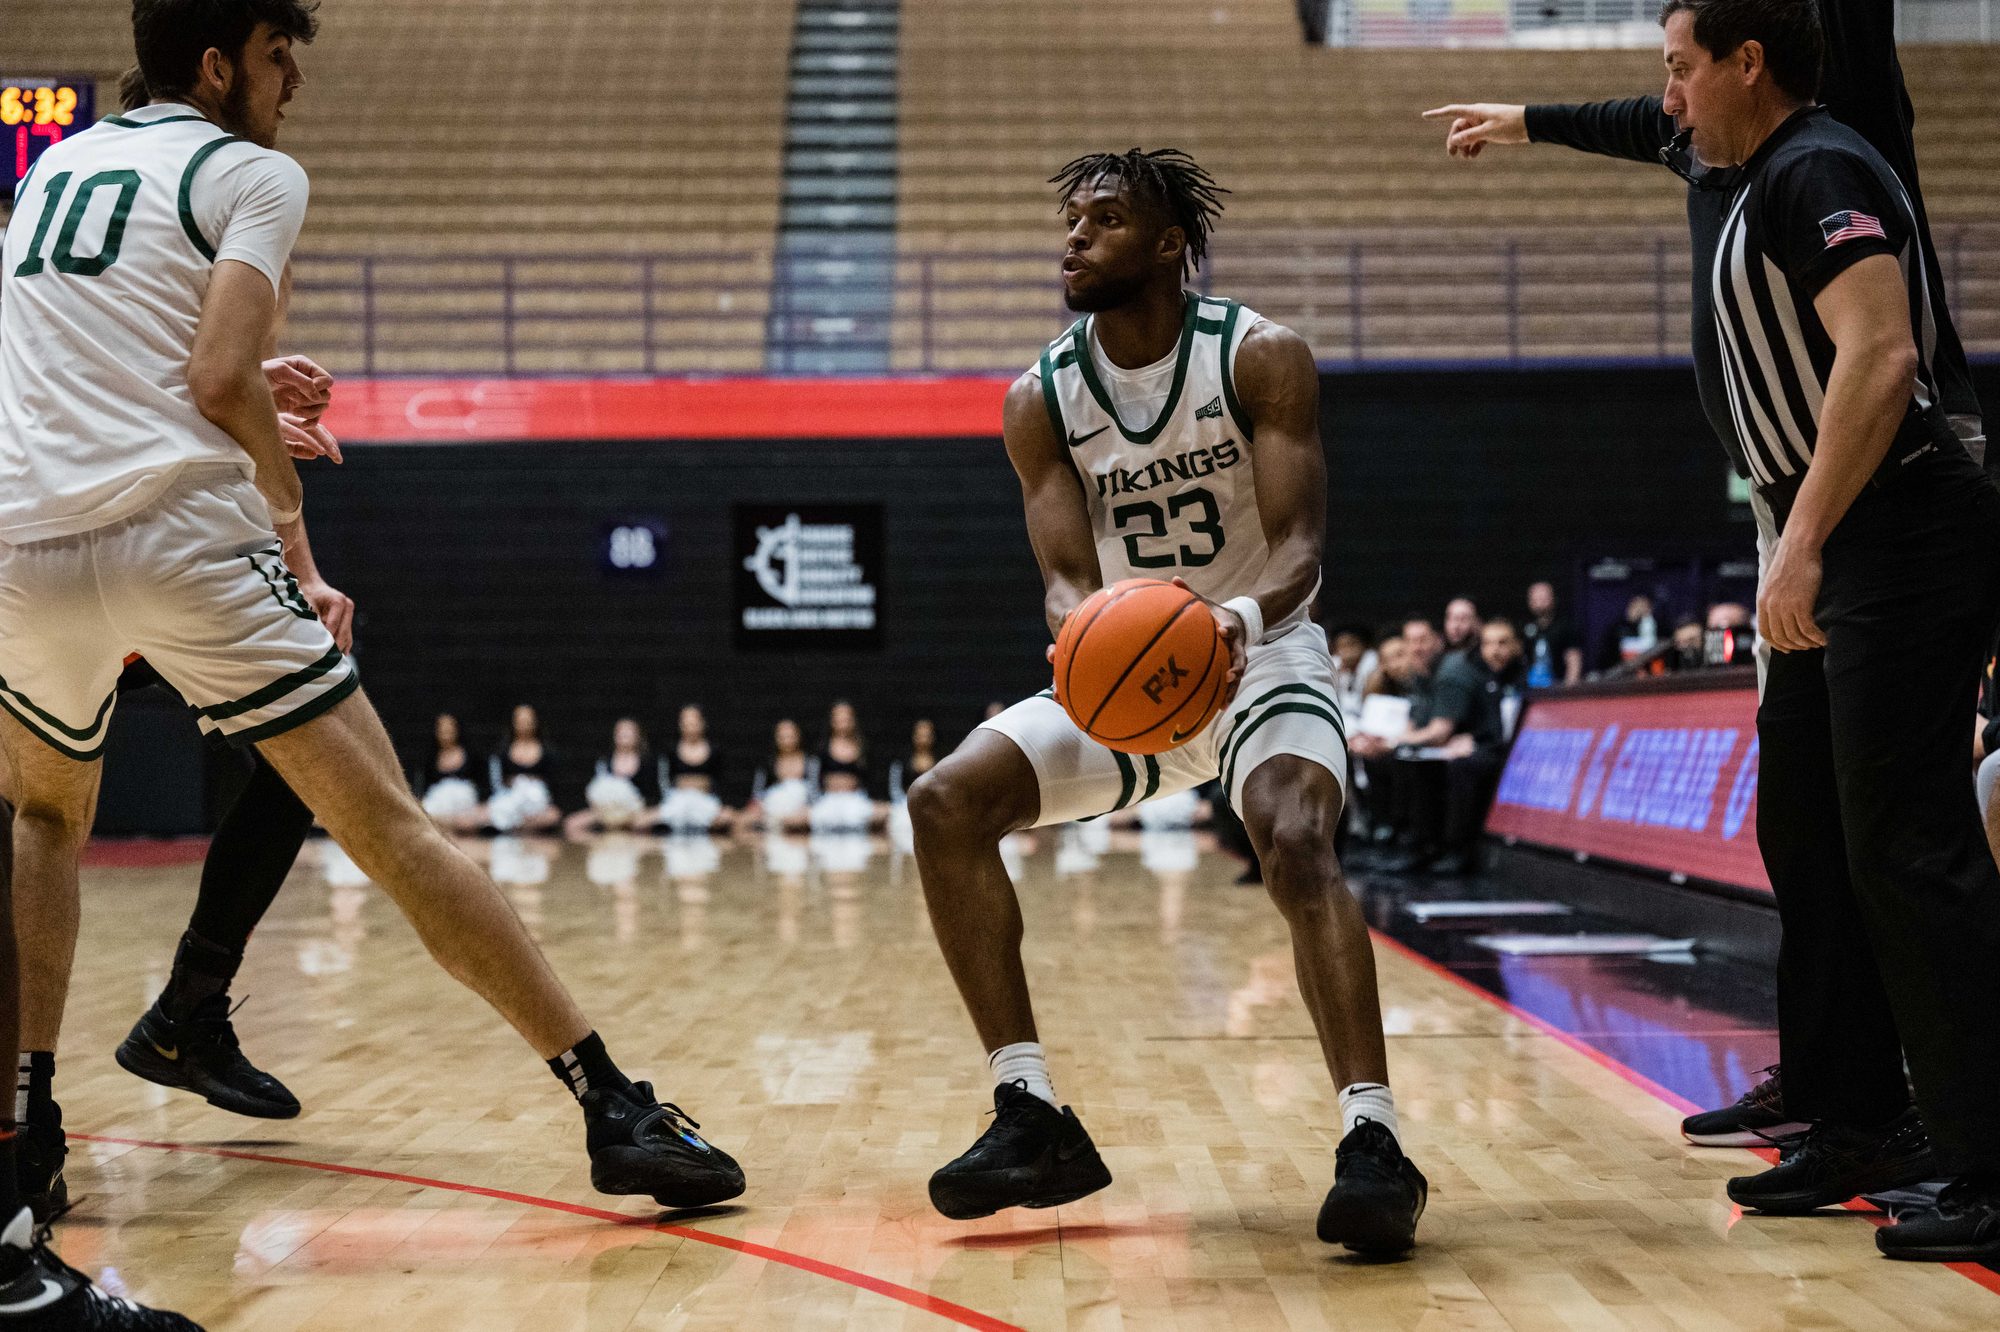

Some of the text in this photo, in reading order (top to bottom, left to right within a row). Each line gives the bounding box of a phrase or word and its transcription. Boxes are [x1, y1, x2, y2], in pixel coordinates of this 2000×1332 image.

[0, 87, 77, 126] 6:32
[14, 169, 142, 277] 10
[1113, 487, 1226, 568] 23
